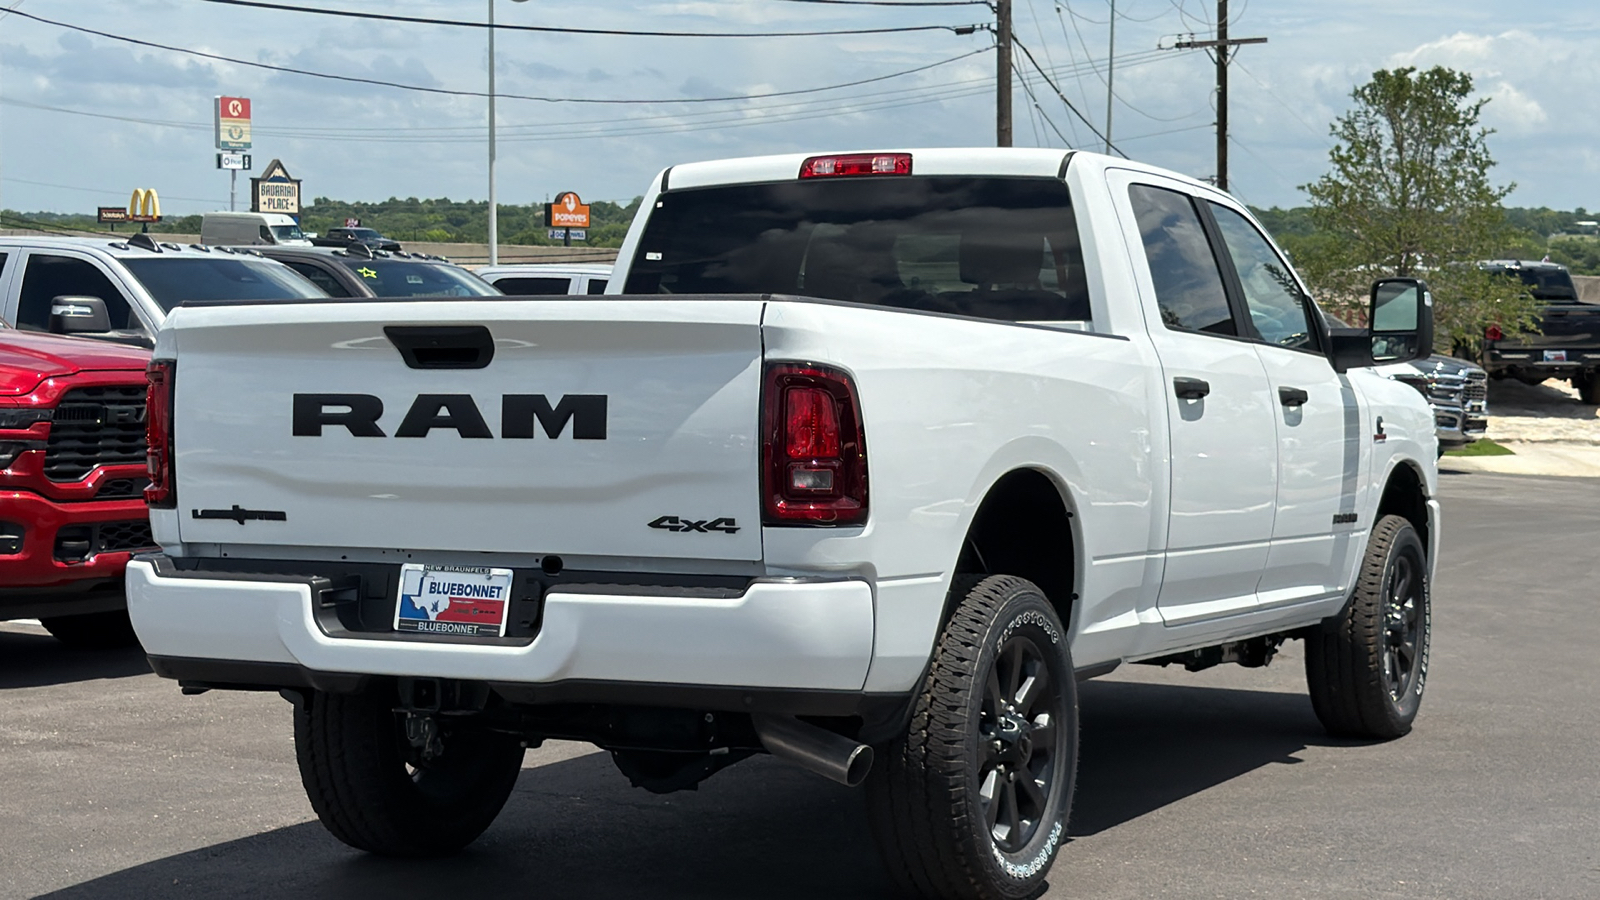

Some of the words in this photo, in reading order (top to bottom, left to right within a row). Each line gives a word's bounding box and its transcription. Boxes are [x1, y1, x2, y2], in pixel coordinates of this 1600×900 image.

[261, 185, 296, 197] BAVARIAN
[268, 198, 289, 209] PLACE
[555, 213, 587, 222] POPEYES
[292, 393, 608, 439] RAM
[647, 516, 741, 534] 4x4
[429, 582, 502, 598] BLUEBONNET
[418, 621, 478, 634] BLUEBONNET
